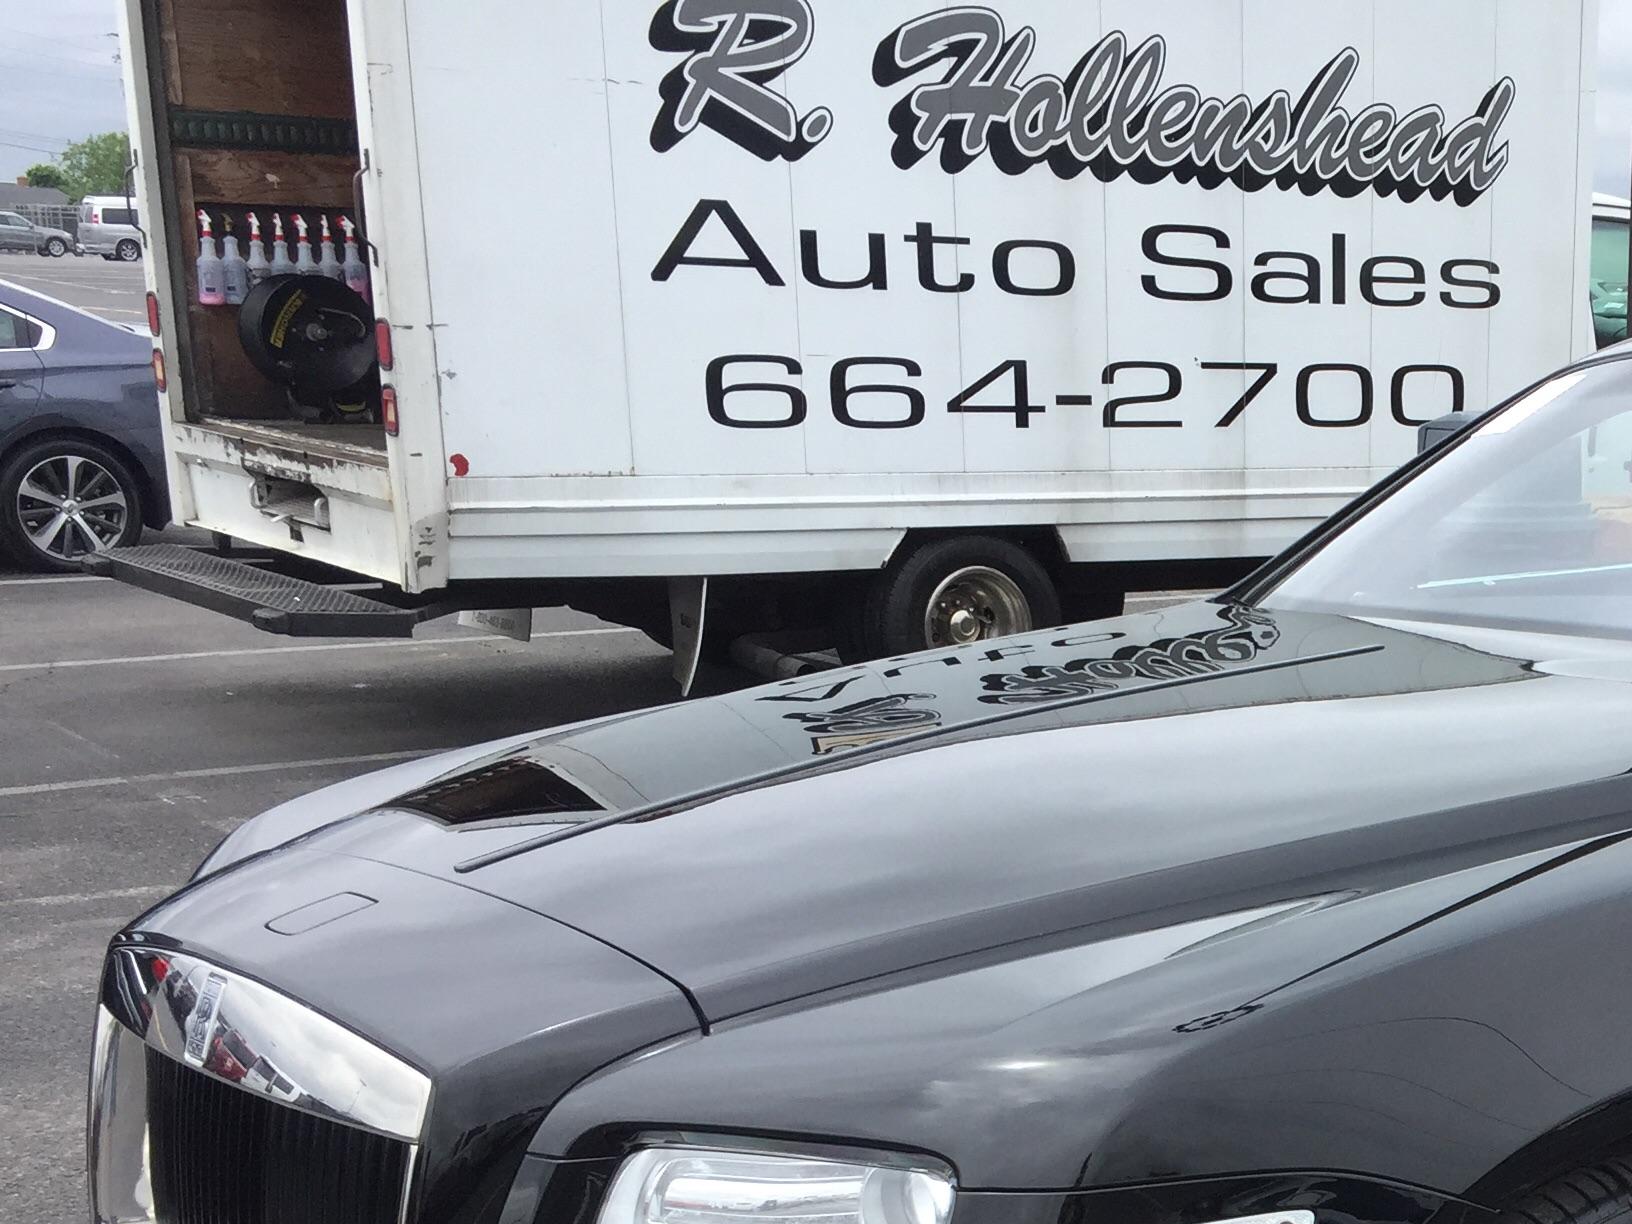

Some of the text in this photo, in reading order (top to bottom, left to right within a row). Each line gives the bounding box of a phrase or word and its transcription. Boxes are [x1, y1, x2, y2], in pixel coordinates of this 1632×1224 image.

[649, 0, 1516, 208] R. Hollenshead
[650, 198, 1502, 309] Auto Sales
[705, 353, 1465, 430] 664-2700
